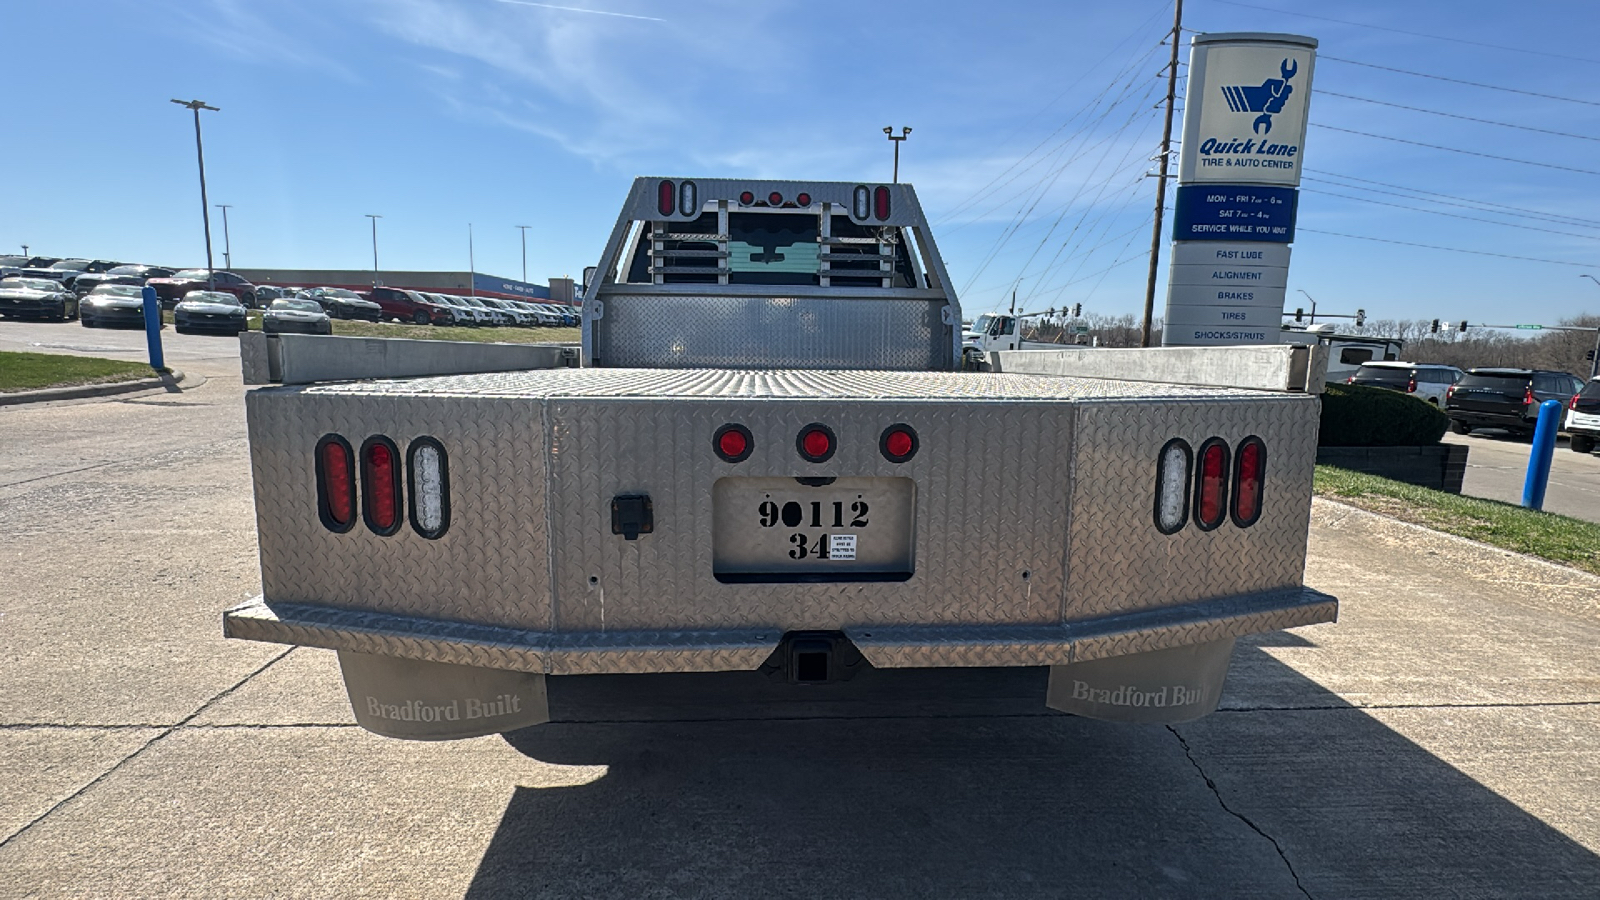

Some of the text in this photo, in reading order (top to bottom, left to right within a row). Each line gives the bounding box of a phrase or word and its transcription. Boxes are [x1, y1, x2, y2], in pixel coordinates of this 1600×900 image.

[1200, 138, 1298, 157] Quick Lane
[1202, 158, 1294, 169] TIRE & AUTO CENTER
[1206, 195, 1227, 203] MON
[1236, 195, 1249, 203] FRI
[1219, 210, 1234, 218] SAT
[1191, 224, 1227, 233] SERVICE
[1229, 224, 1253, 233] WHILE
[1256, 225, 1270, 234] YOU
[1216, 250, 1263, 260] FAST LUBE
[1212, 271, 1263, 280] ALIGNMENT
[1217, 291, 1254, 301] BRAKES
[1221, 312, 1246, 321] TIRES
[1194, 331, 1265, 341] SHOCKS/STRUTS
[758, 500, 869, 528] 90112
[1071, 680, 1207, 708] Bradford Bui
[366, 694, 522, 722] Bradford Built
